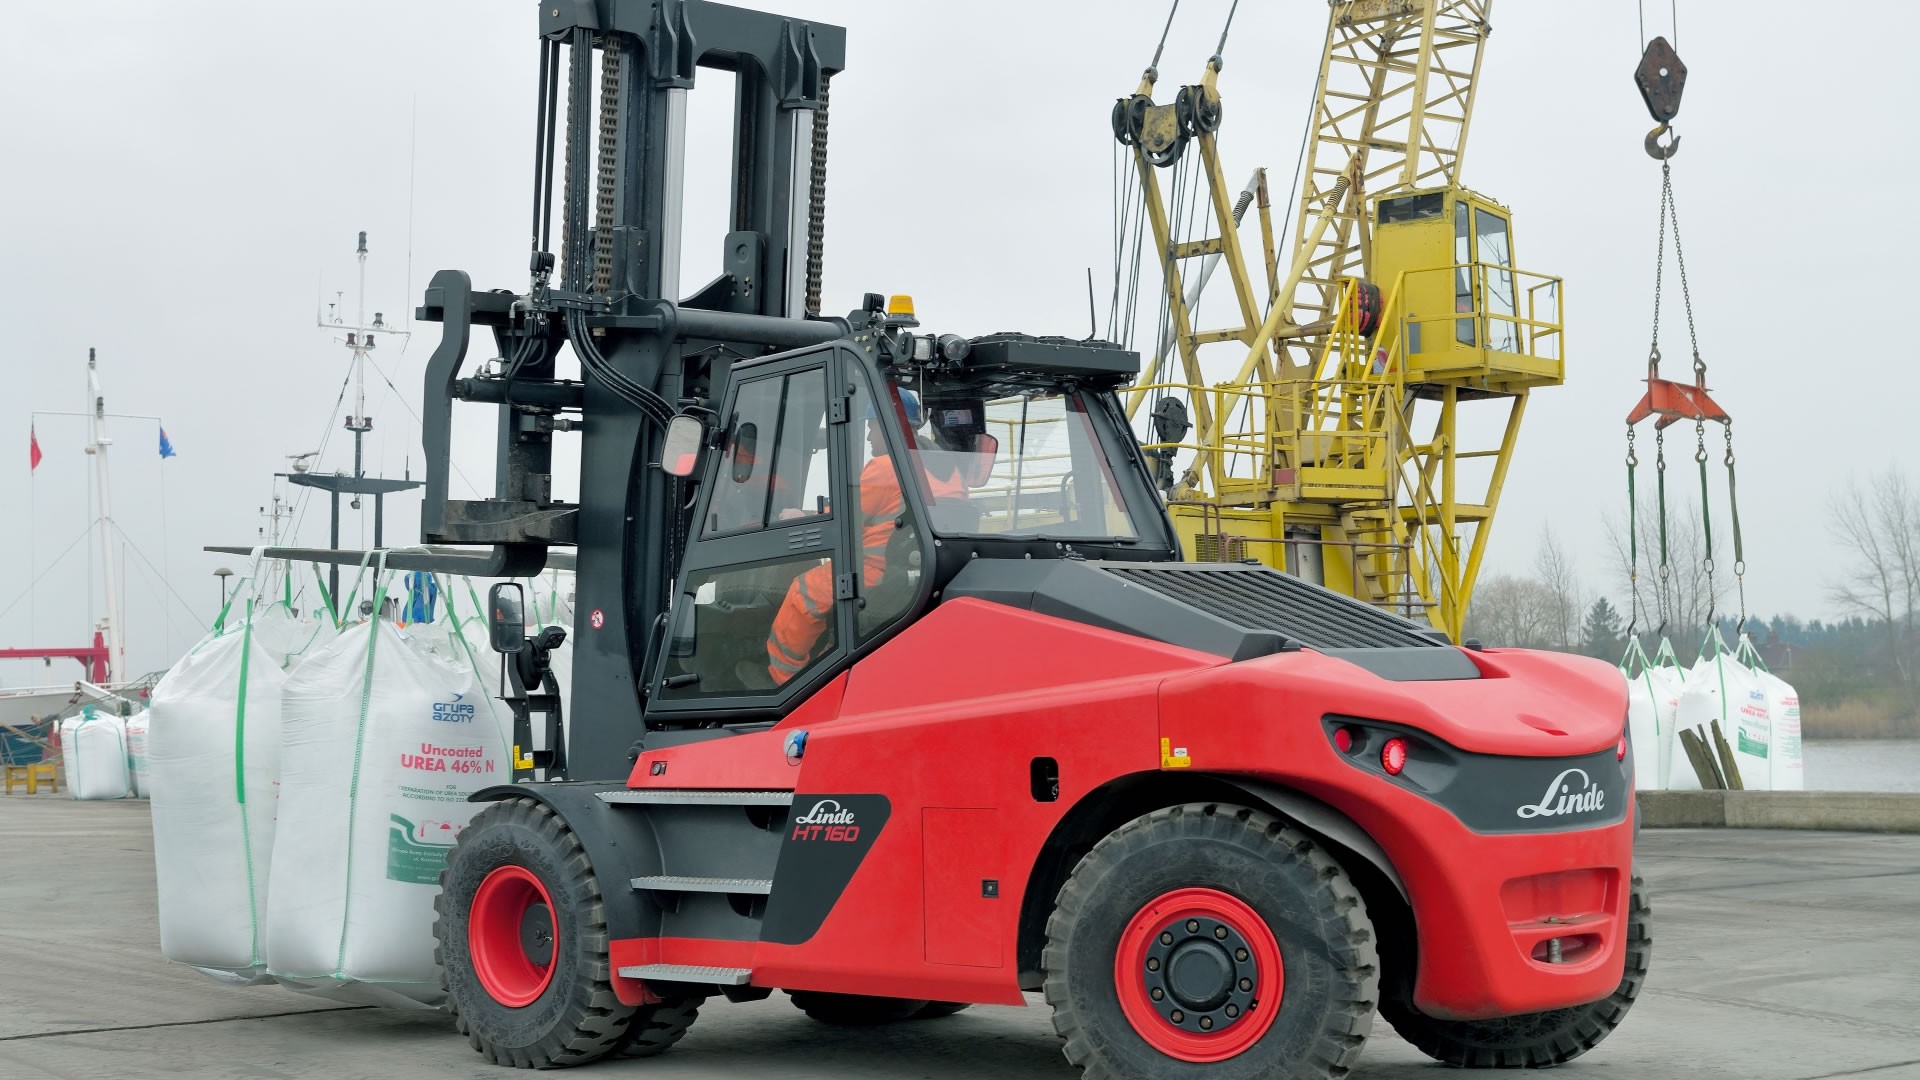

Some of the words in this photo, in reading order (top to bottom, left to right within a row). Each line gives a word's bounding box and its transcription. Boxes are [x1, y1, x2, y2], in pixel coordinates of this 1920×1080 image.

[422, 743, 483, 758] Uncoated
[401, 754, 446, 772] UREA
[451, 760, 482, 774] 46%
[485, 760, 495, 773] N
[1517, 768, 1605, 819] Linde
[795, 799, 855, 825] Linde
